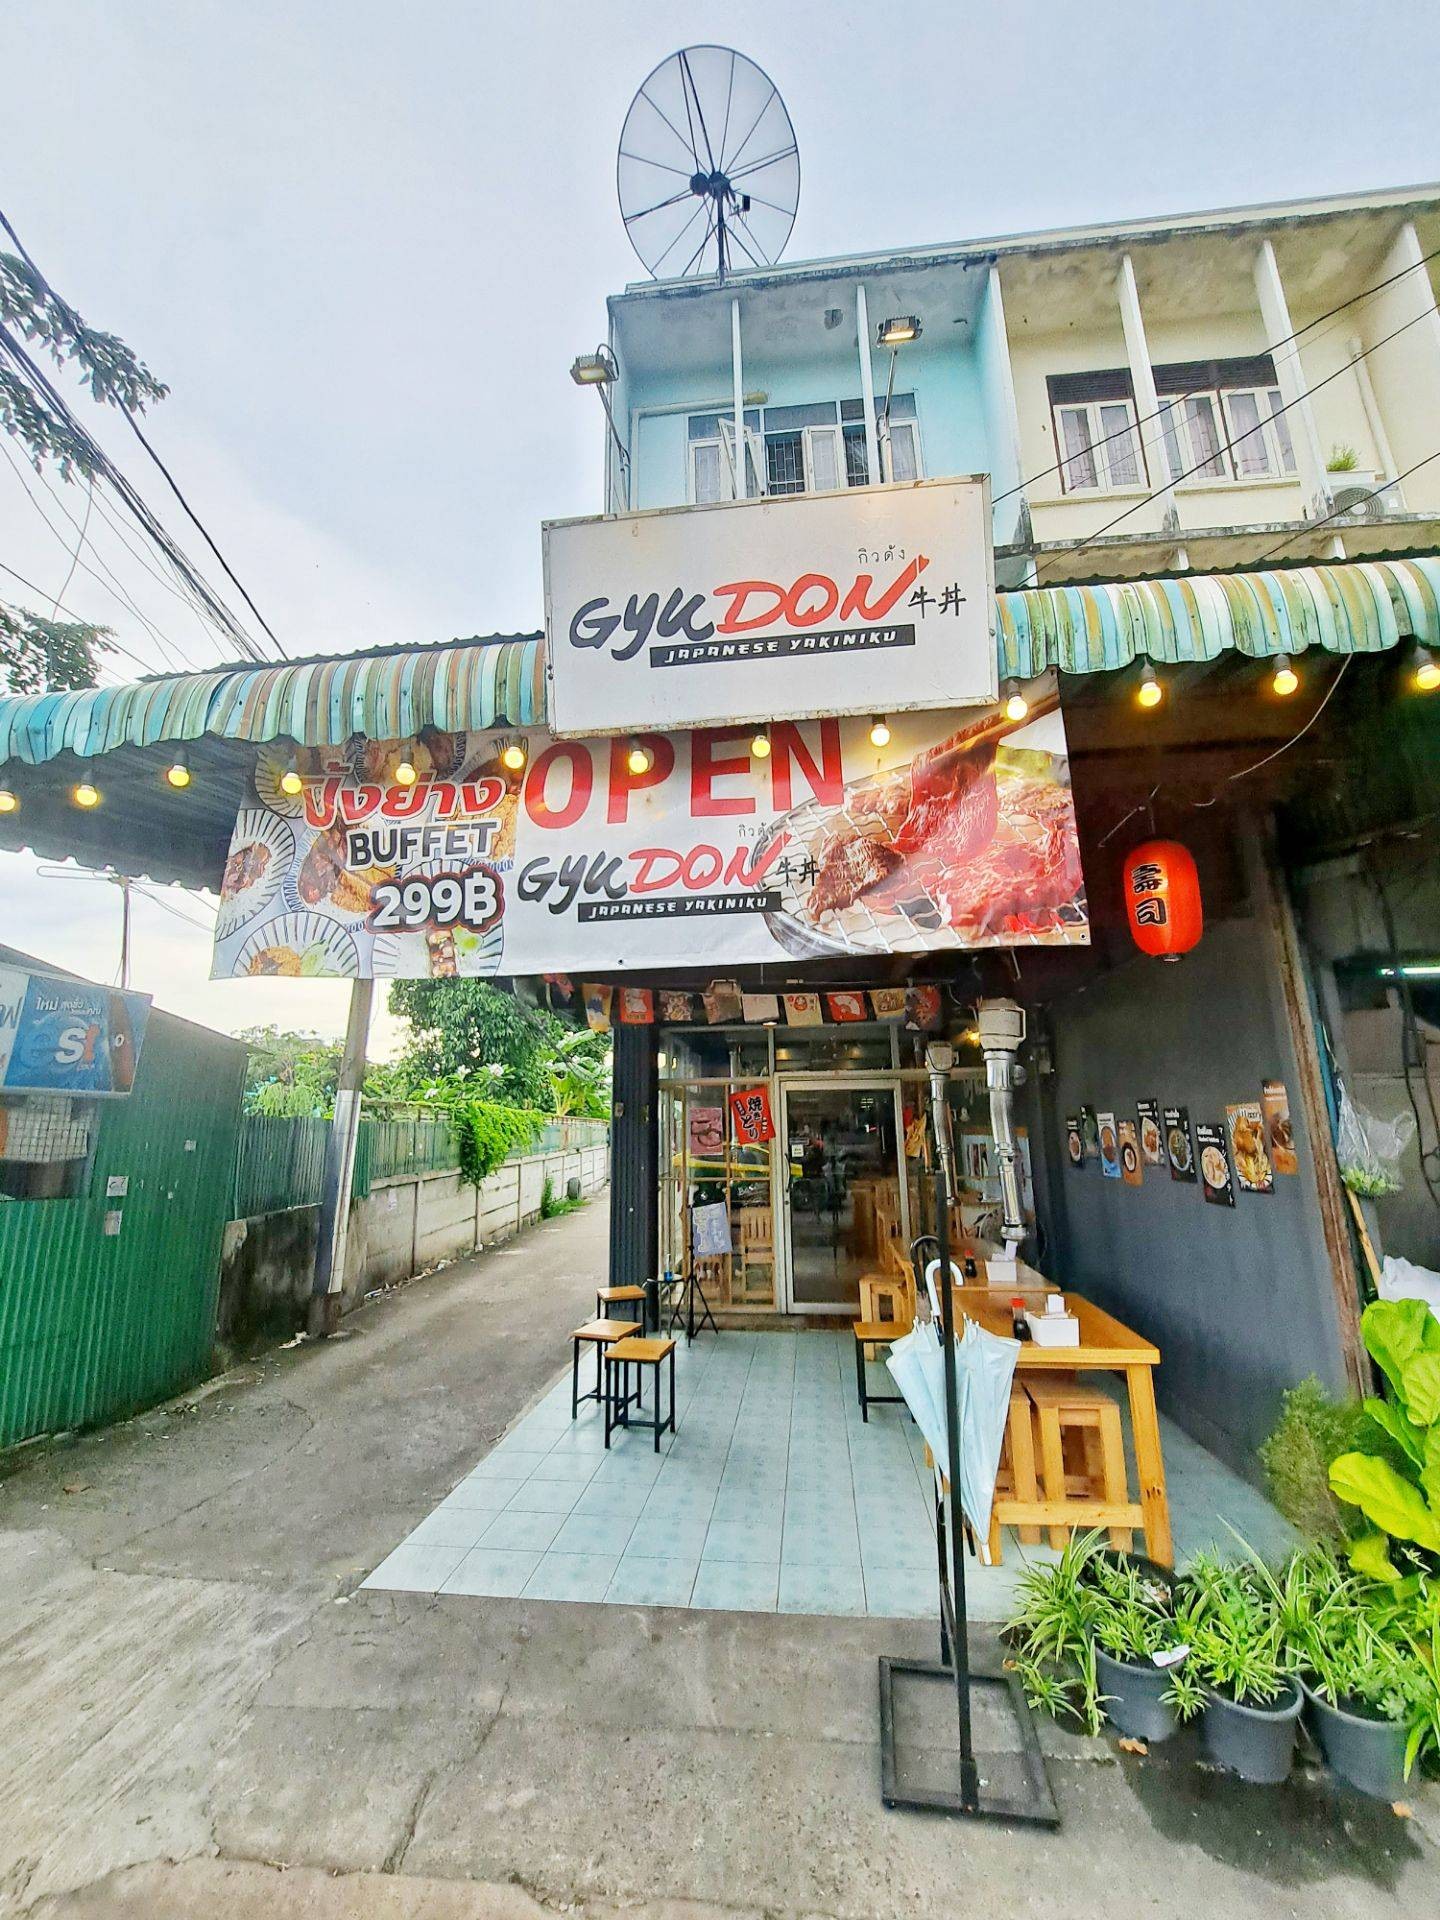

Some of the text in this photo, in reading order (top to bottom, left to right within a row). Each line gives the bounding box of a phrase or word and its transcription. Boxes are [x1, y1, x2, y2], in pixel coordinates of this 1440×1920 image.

[907, 582, 967, 619] 牛丼
[664, 630, 899, 663] JAPANESE YAKINIKU
[524, 717, 846, 830] OPEN
[349, 821, 499, 868] BUFFET
[777, 855, 820, 887] 牛丼
[588, 896, 768, 919] JAPANESE YAKINIKU
